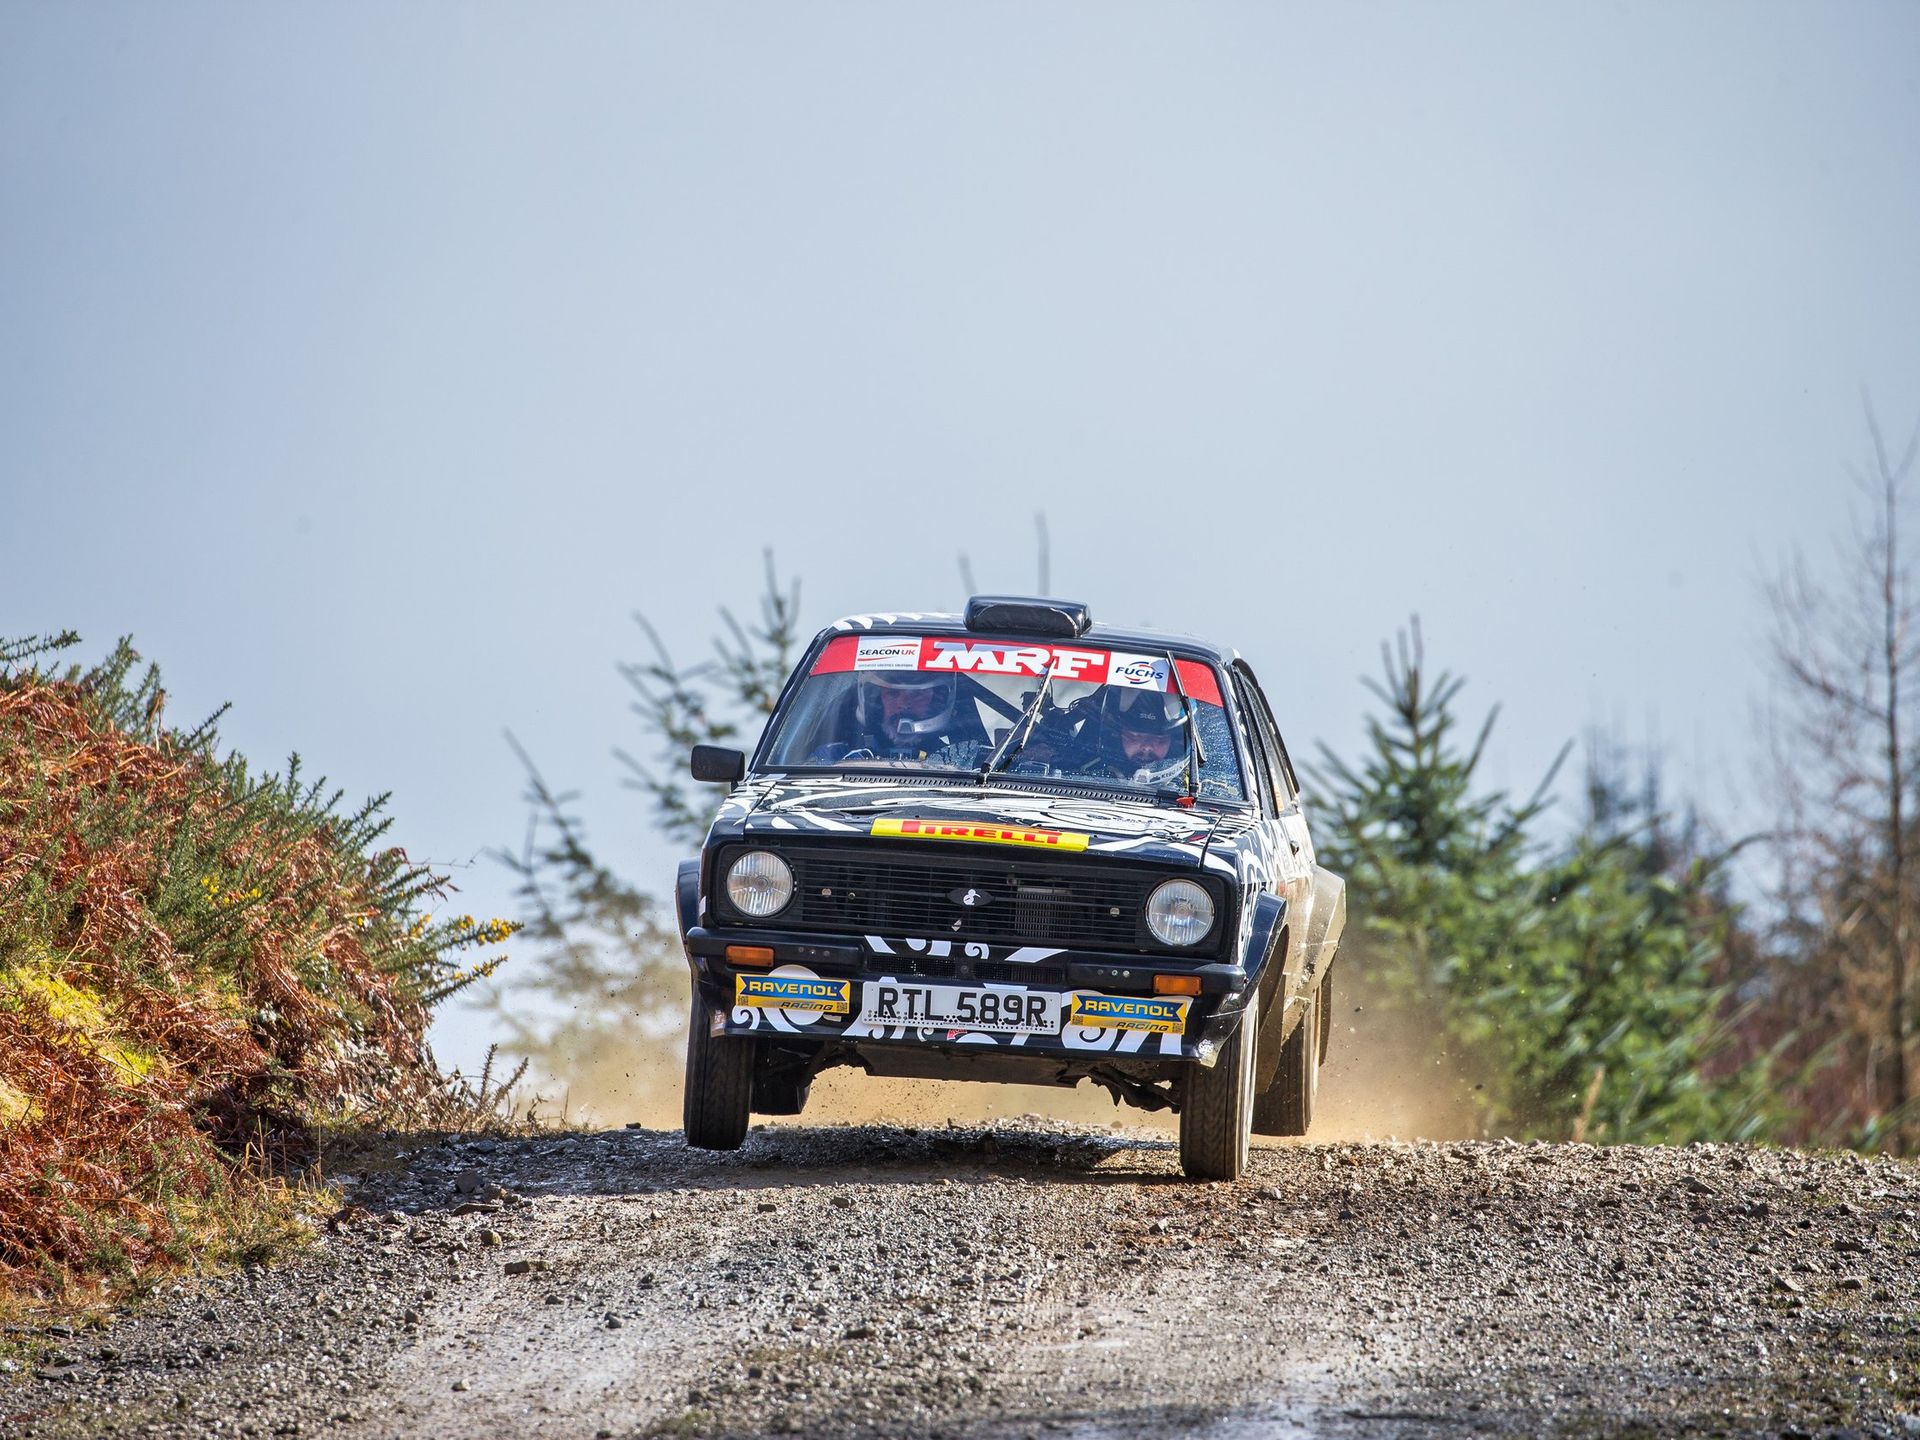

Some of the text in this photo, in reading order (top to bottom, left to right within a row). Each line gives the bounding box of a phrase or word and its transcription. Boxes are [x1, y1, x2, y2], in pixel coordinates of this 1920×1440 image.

[925, 641, 1105, 678] MRF
[1115, 666, 1164, 680] FUCHS
[901, 820, 1063, 845] PIRELLI
[749, 981, 837, 997] RAVENOL
[780, 1001, 834, 1011] RACING
[878, 986, 1047, 1027] RTL 589R
[1085, 999, 1174, 1018] RAVENOL
[1116, 1021, 1169, 1032] RACING
